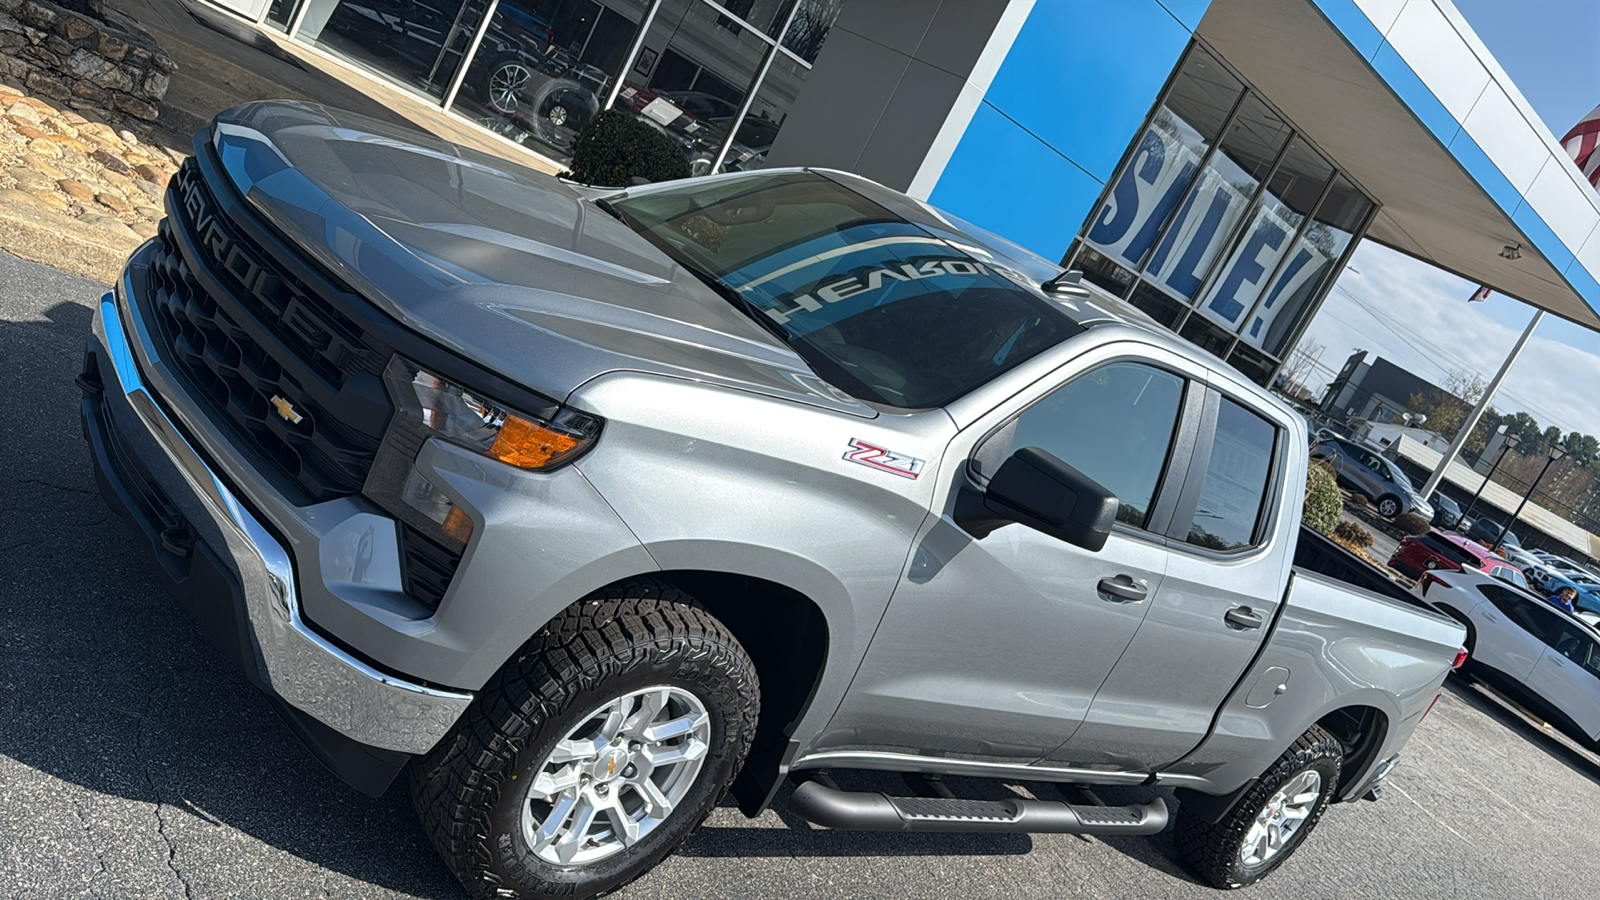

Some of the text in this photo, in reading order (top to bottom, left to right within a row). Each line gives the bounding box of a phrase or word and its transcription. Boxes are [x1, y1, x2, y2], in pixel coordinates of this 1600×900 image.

[177, 161, 366, 368] CHEVROLET
[1088, 129, 1313, 338] SALE!
[842, 437, 926, 480] Z71
